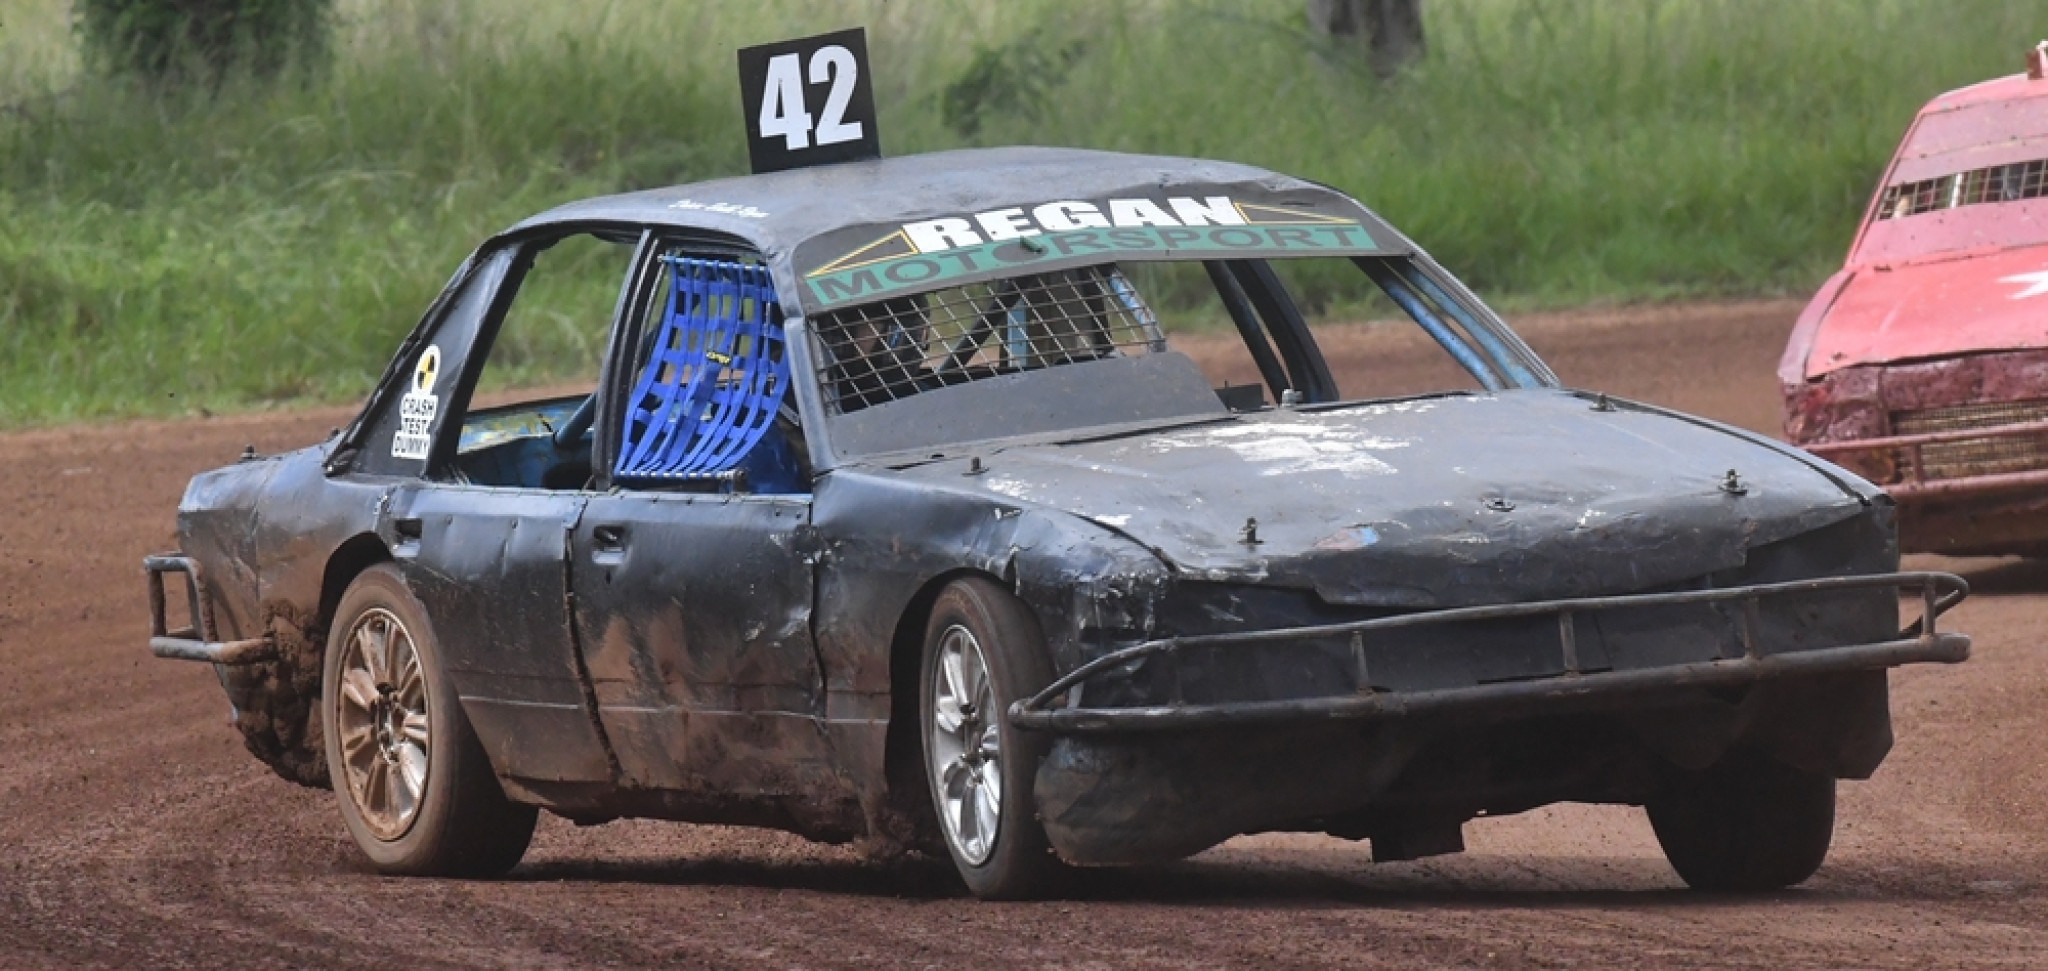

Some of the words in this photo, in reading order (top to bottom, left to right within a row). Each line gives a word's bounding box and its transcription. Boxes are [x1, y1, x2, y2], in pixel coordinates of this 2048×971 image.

[760, 45, 863, 150] 42
[901, 196, 1248, 253] REGAN
[818, 226, 1358, 301] MOTORSPORT
[402, 398, 435, 416] CRASH
[394, 435, 428, 453] DUMMY
[402, 417, 428, 435] TEST
